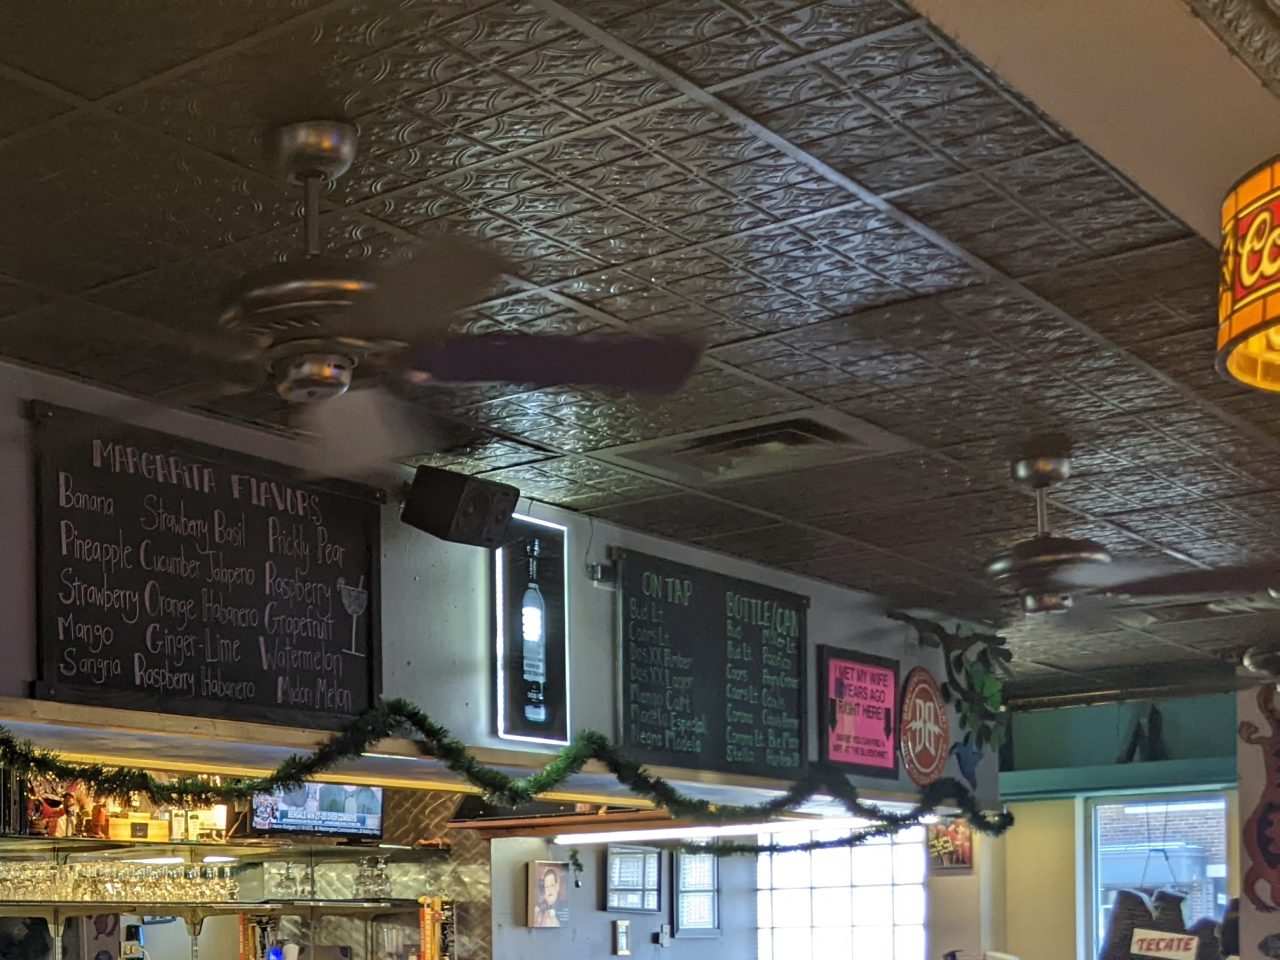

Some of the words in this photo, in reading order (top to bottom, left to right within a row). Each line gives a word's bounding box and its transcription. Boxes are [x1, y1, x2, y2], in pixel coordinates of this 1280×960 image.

[59, 471, 115, 517] Banana
[230, 474, 323, 525] FLAVORS
[60, 519, 134, 573] Pineapple
[140, 493, 210, 555] Strawberry
[213, 508, 246, 548] Basil
[268, 515, 311, 575] Prickly
[316, 525, 345, 569] Pear
[139, 539, 201, 578] Cucumber
[58, 567, 141, 625] Strawberry
[144, 579, 198, 631] Orange
[641, 571, 662, 598] ON
[664, 577, 693, 606] TAP
[57, 612, 115, 654] Mango
[258, 633, 344, 678] Watermelon
[59, 647, 121, 684] Sangria
[133, 652, 197, 698] Raspberry
[1135, 937, 1195, 952] TECATE
